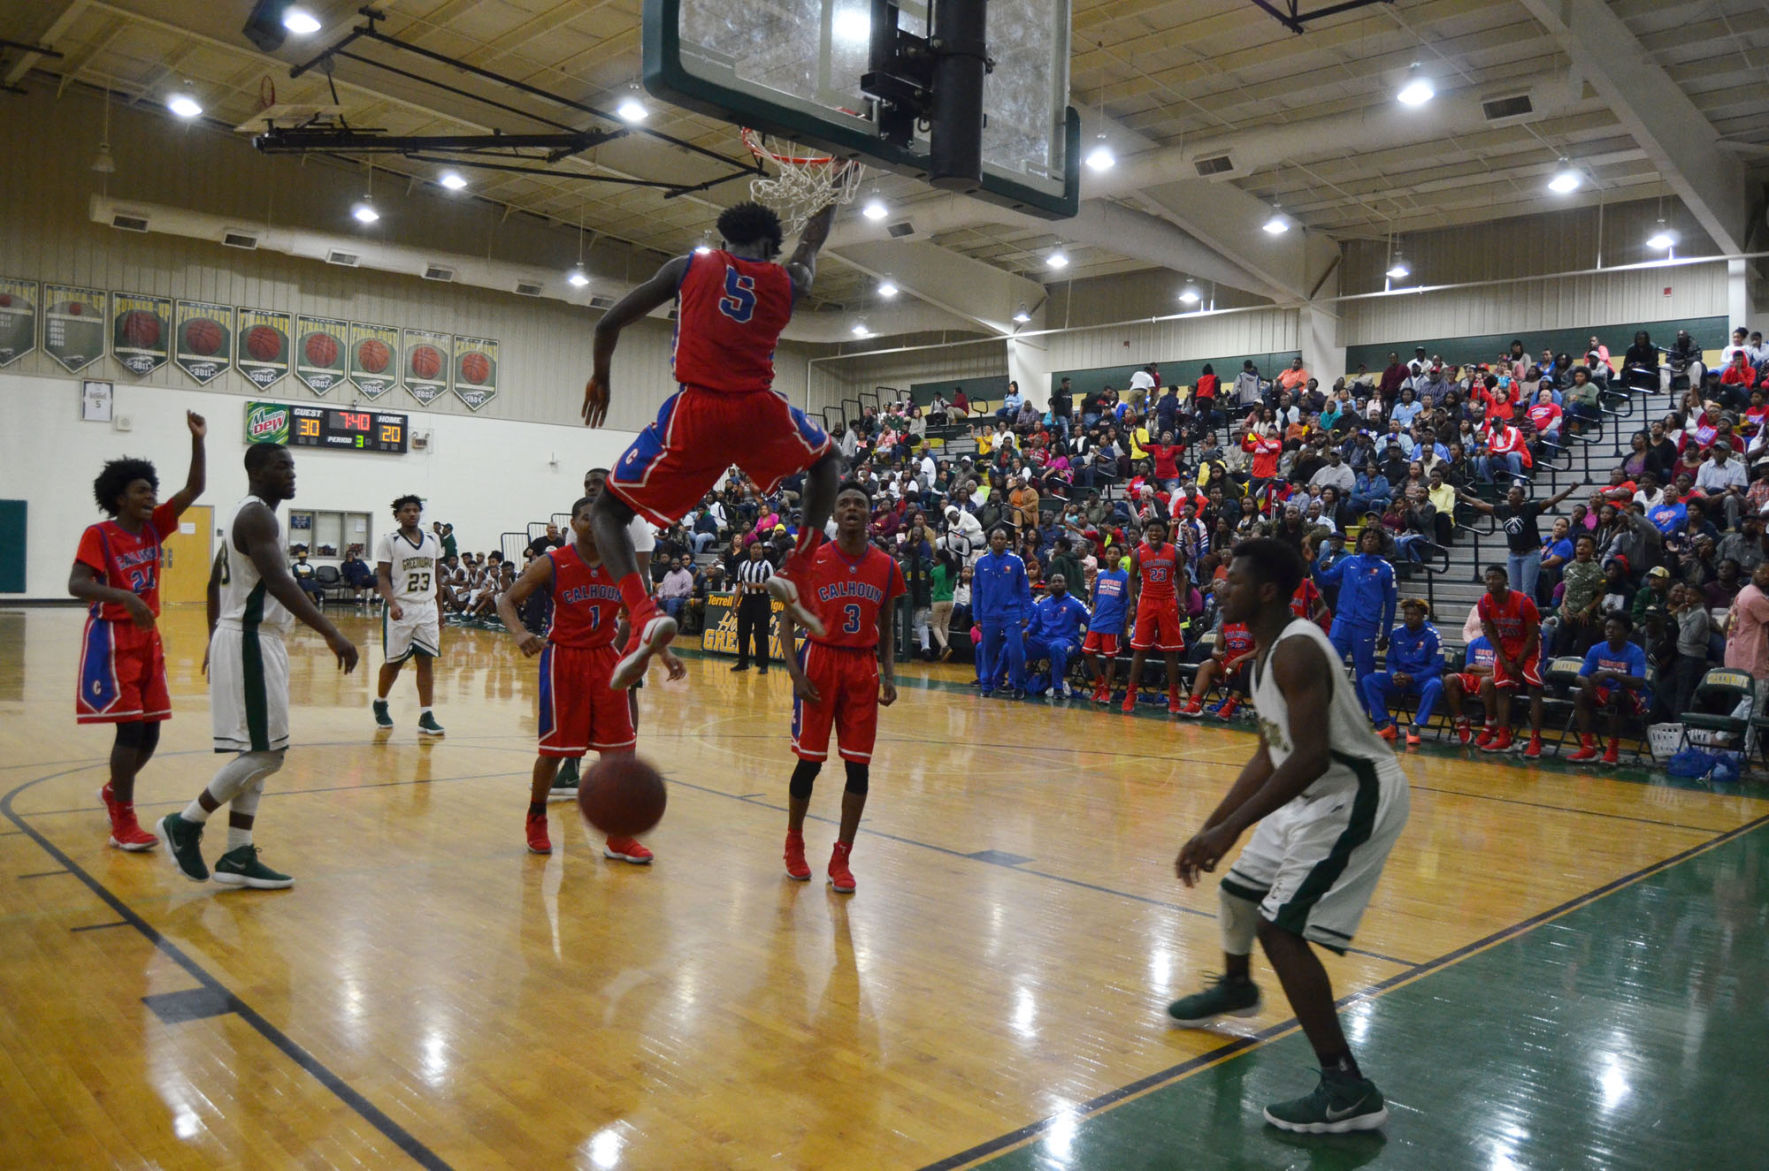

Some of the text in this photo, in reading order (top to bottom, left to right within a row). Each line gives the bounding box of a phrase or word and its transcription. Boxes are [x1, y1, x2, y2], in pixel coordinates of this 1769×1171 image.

[719, 264, 757, 323] 5
[293, 408, 323, 417] GUEST
[339, 411, 371, 431] 7:40
[377, 415, 404, 424] HOME
[299, 418, 320, 437] 30
[382, 425, 401, 443] 20
[327, 436, 353, 444] PERIOD
[355, 435, 364, 448] 3
[407, 572, 431, 592] 23
[1149, 567, 1167, 582] 23
[707, 594, 734, 607] Terrell
[817, 581, 883, 605] CALHOUN
[589, 605, 600, 631] 1
[843, 603, 861, 633] 3
